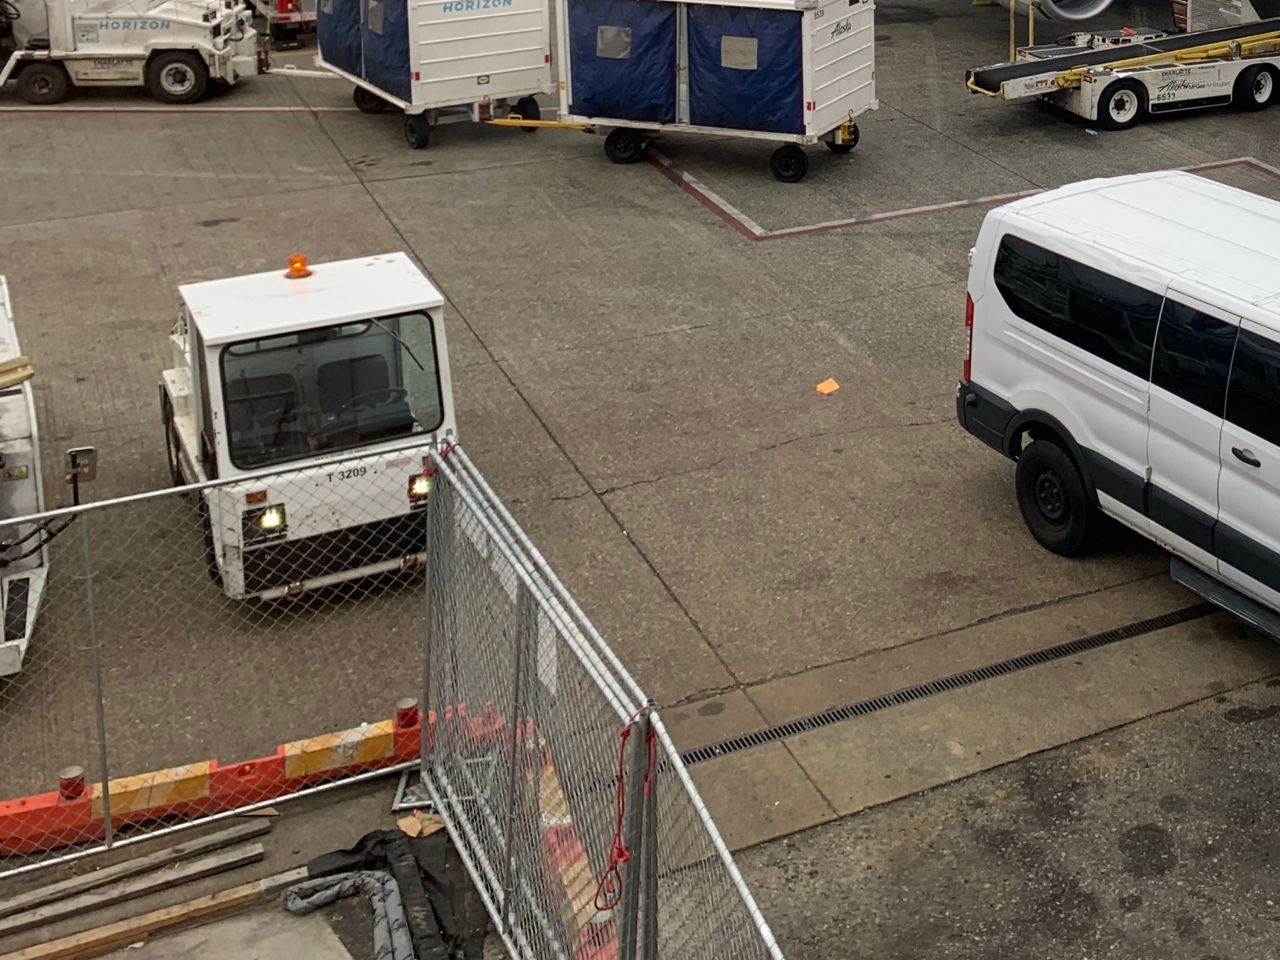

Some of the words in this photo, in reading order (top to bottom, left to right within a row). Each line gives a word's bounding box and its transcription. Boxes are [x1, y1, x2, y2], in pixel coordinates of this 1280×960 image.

[99, 20, 171, 30] HORIZON
[325, 472, 334, 482] T
[338, 466, 367, 481] 3209
